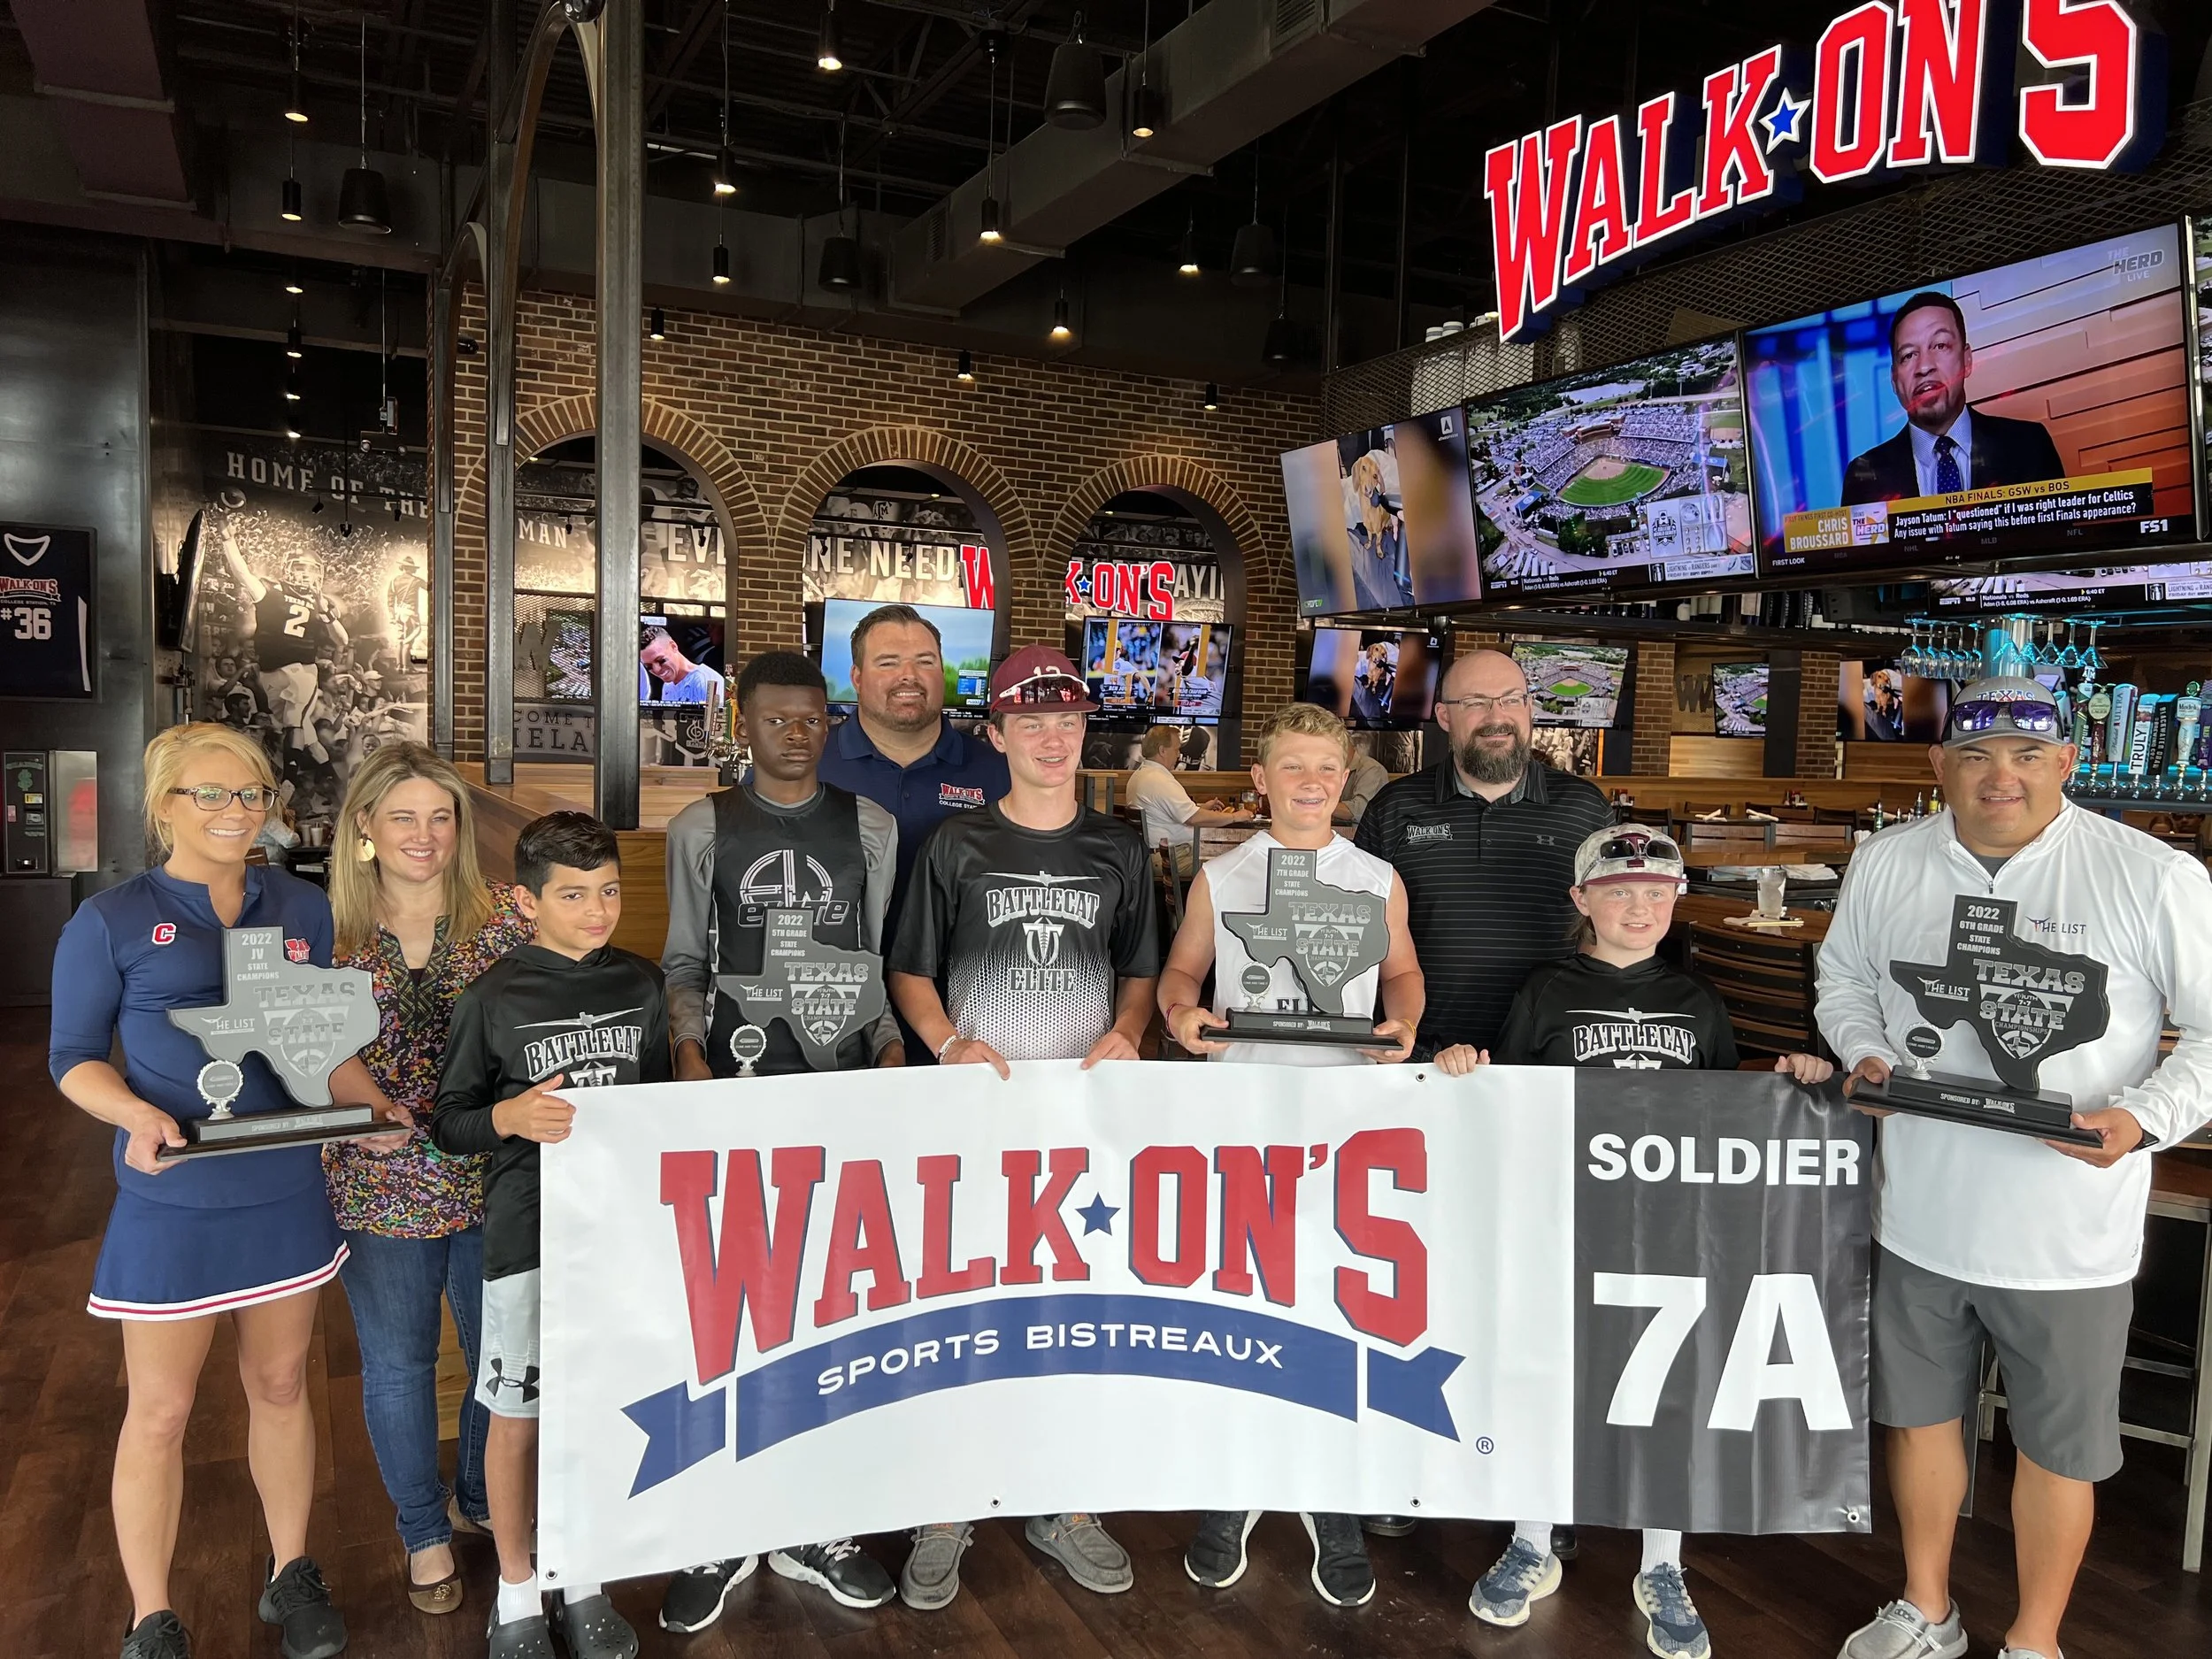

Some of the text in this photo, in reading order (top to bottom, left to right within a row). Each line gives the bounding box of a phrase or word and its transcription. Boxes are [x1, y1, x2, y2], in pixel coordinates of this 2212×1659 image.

[2107, 247, 2130, 261] THE
[2113, 250, 2164, 275] HERD
[2127, 271, 2150, 282] LIVE
[227, 451, 365, 504] HOME OF
[1946, 495, 1965, 505] NBA
[1968, 489, 2006, 502] FINALS:
[2008, 486, 2032, 496] GSW
[2048, 480, 2070, 492] BOS
[1895, 516, 1920, 527] Jayson
[1922, 512, 1947, 523] Tatum:
[2004, 503, 2011, 514] if
[2017, 503, 2034, 512] was
[2036, 498, 2056, 511] right
[2058, 495, 2085, 508] leader
[2088, 494, 2101, 504] for
[2103, 490, 2134, 503] Celtics
[1818, 517, 1848, 534] CHRIS
[1856, 522, 1886, 535] HERD
[1894, 502, 2137, 540] Any issue with Tatum saying this before first Finals appearance?
[2140, 518, 2169, 534] FS1
[1790, 532, 1849, 550] BROUSSARD
[870, 541, 956, 581] NEED
[2169, 583, 2194, 592] LIGHTNING
[284, 604, 310, 638] 2
[2131, 728, 2147, 771] TRULY
[1281, 855, 1305, 866] 2022
[1275, 888, 1309, 897] CHAMPIONS
[986, 887, 1100, 929] BATTLECAT
[1288, 902, 1371, 924] TEXAS
[1967, 904, 2001, 920] 2022
[778, 915, 803, 926] 2022
[1959, 920, 2004, 934] 6TH GRADE
[2062, 923, 2086, 934] LIST
[151, 922, 177, 945] C
[242, 933, 272, 946] 2022
[786, 929, 807, 938] GRADE
[1969, 934, 1991, 945] STATE
[251, 948, 264, 960] JV
[1295, 938, 1360, 956] STATE
[1957, 942, 2001, 956] CHAMPIONS
[237, 972, 280, 981] CHAMPIONS
[784, 962, 869, 982] TEXAS
[1009, 968, 1076, 993] ELITE
[1973, 958, 2085, 994] TEXAS
[254, 981, 356, 1009] TEXAS
[1948, 985, 1970, 997] LIST
[791, 998, 856, 1015] STATE
[234, 1018, 255, 1029] LIST
[1979, 1001, 2066, 1031] STATE
[267, 1022, 346, 1045] STATE
[1994, 1021, 2048, 1034] CHAMPIONSHIPS
[1572, 1023, 1696, 1065] BATTLECAT
[524, 1026, 642, 1082] BATTLECAT
[1940, 1093, 1970, 1104] SPONSORED
[1589, 1133, 1861, 1188] SOLDIER
[659, 1127, 1429, 1386] WALK ON'S
[817, 1318, 1285, 1396] SPORTS BISTREAUX
[1594, 1271, 1853, 1432] 7A
